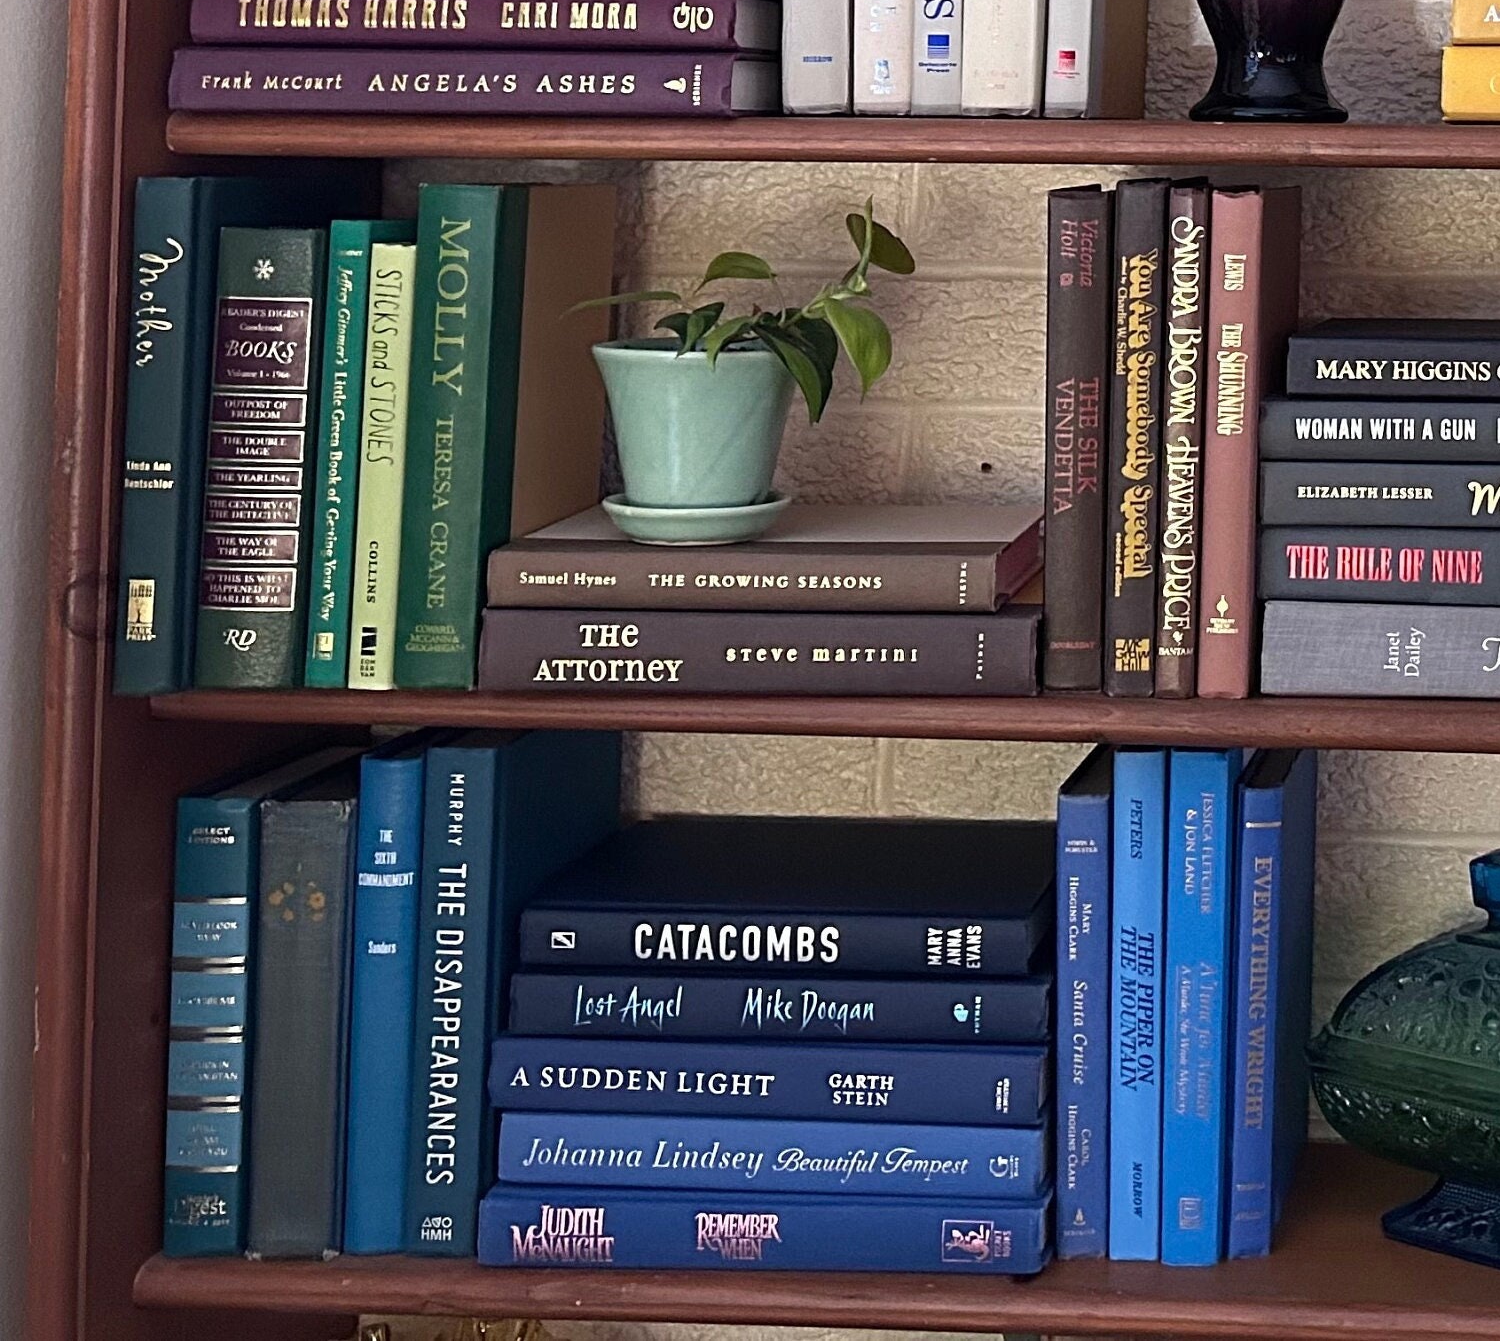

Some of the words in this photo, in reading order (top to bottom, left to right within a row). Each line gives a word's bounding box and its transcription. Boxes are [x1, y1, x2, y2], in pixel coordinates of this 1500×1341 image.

[201, 74, 253, 91] Frank
[263, 75, 343, 91] McCourt
[368, 73, 518, 93] ANGELA'S
[536, 75, 636, 94] ASHES
[1171, 217, 1203, 317] SANDRA
[432, 216, 472, 397] MOLLY
[1168, 322, 1202, 426] BROWN
[1316, 359, 1388, 381] MARY
[1393, 361, 1491, 382] HIGGINS
[1296, 418, 1363, 440] WOMAN
[1370, 419, 1416, 441] WITH
[1421, 419, 1433, 440] A
[1440, 419, 1476, 441] GUN
[432, 415, 454, 512] TERESA
[1297, 485, 1379, 499] ELIZABETH
[1382, 486, 1433, 500] LESSER
[366, 540, 379, 604] COLLINS
[427, 522, 450, 609] CRANE
[519, 572, 569, 586] Samuel
[573, 572, 616, 588] Hynes
[649, 574, 686, 587] THE
[695, 574, 789, 588] GROWING
[798, 575, 883, 589] SEASONS
[1383, 631, 1400, 672] Janet
[1404, 627, 1426, 678] Dailey
[447, 773, 465, 846] MURPHY
[1129, 799, 1143, 860] PETERS
[436, 863, 467, 916] THE
[634, 923, 839, 963] CATACOMBS
[928, 927, 942, 966] MARY
[947, 928, 962, 966] ANNA
[967, 924, 982, 969] EVANS
[426, 929, 464, 1185] DISAPPEARANCES
[511, 1068, 530, 1087] A
[540, 1067, 667, 1093] SUDDEN
[677, 1072, 775, 1097] LIGHT
[829, 1074, 894, 1091] GARTH
[833, 1092, 889, 1107] STEIN
[523, 1138, 641, 1169] Johanna
[652, 1142, 763, 1178] Lindsey
[771, 1148, 880, 1183] Beautiful
[881, 1147, 968, 1181] Tempest
[421, 1229, 452, 1241] HMH
